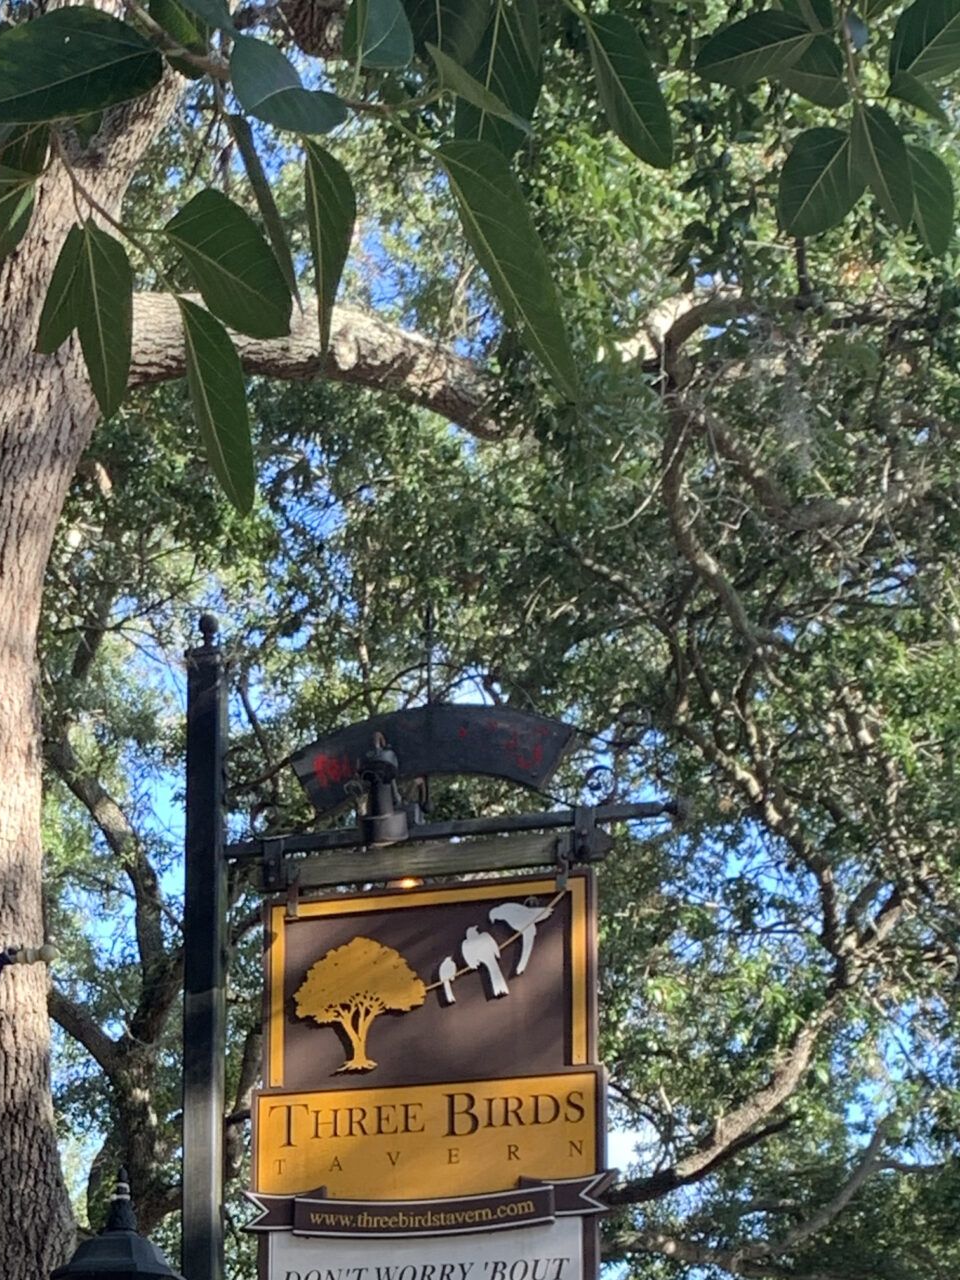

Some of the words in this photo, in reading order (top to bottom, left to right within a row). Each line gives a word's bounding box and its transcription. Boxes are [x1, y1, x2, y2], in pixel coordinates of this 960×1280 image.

[268, 1101, 426, 1148] THREE
[441, 1090, 586, 1138] BIRDS
[275, 1140, 584, 1176] TAVERN
[309, 1199, 536, 1229] www.threebirdstavern.com
